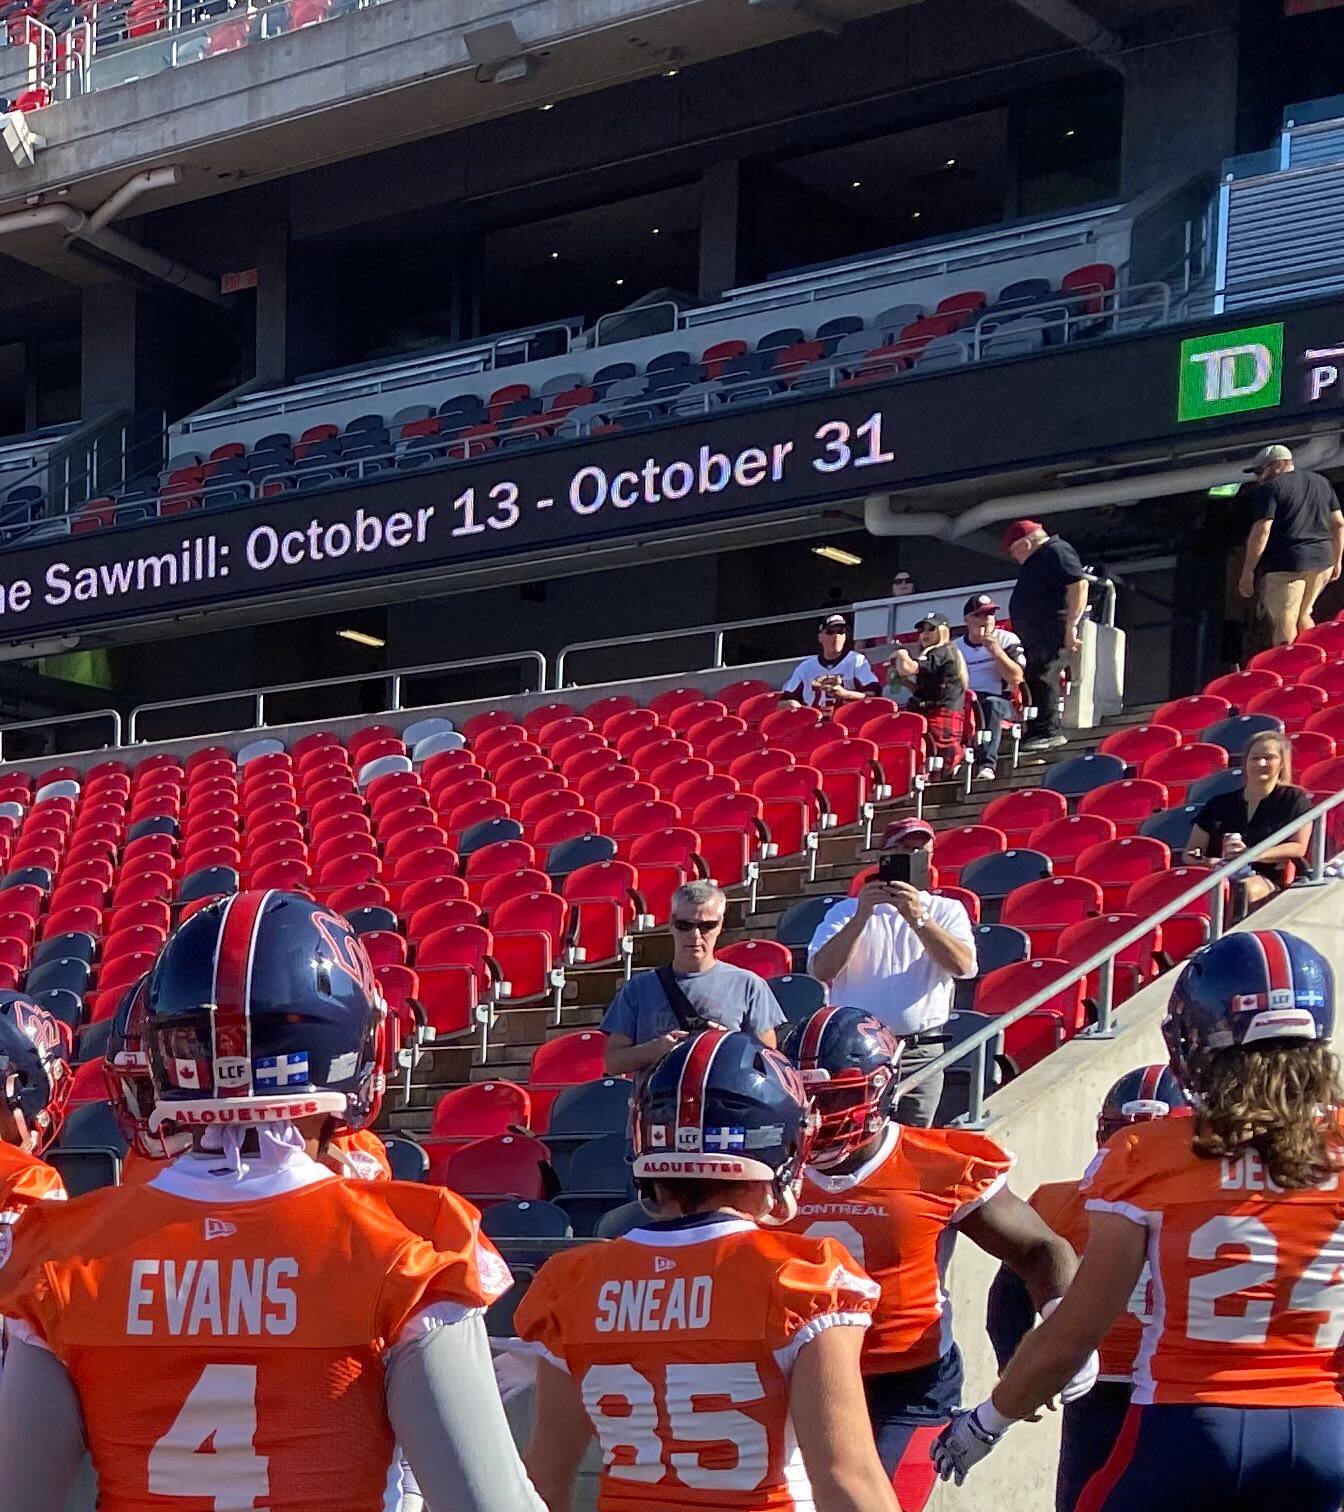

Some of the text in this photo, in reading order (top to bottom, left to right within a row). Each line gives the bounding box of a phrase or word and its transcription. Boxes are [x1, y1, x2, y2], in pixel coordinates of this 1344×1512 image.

[1189, 343, 1272, 402] TD
[44, 536, 231, 606] Sawmill:
[245, 504, 434, 572] October
[450, 481, 519, 538] 13
[568, 442, 794, 517] October
[812, 412, 895, 473] 31
[218, 1065, 247, 1080] LCF
[175, 1100, 319, 1124] ALOUETTES
[643, 1161, 744, 1174] ALOUETTES
[126, 1256, 299, 1336] EVANS
[594, 1275, 713, 1333] SNEAD
[581, 1361, 770, 1492] 85
